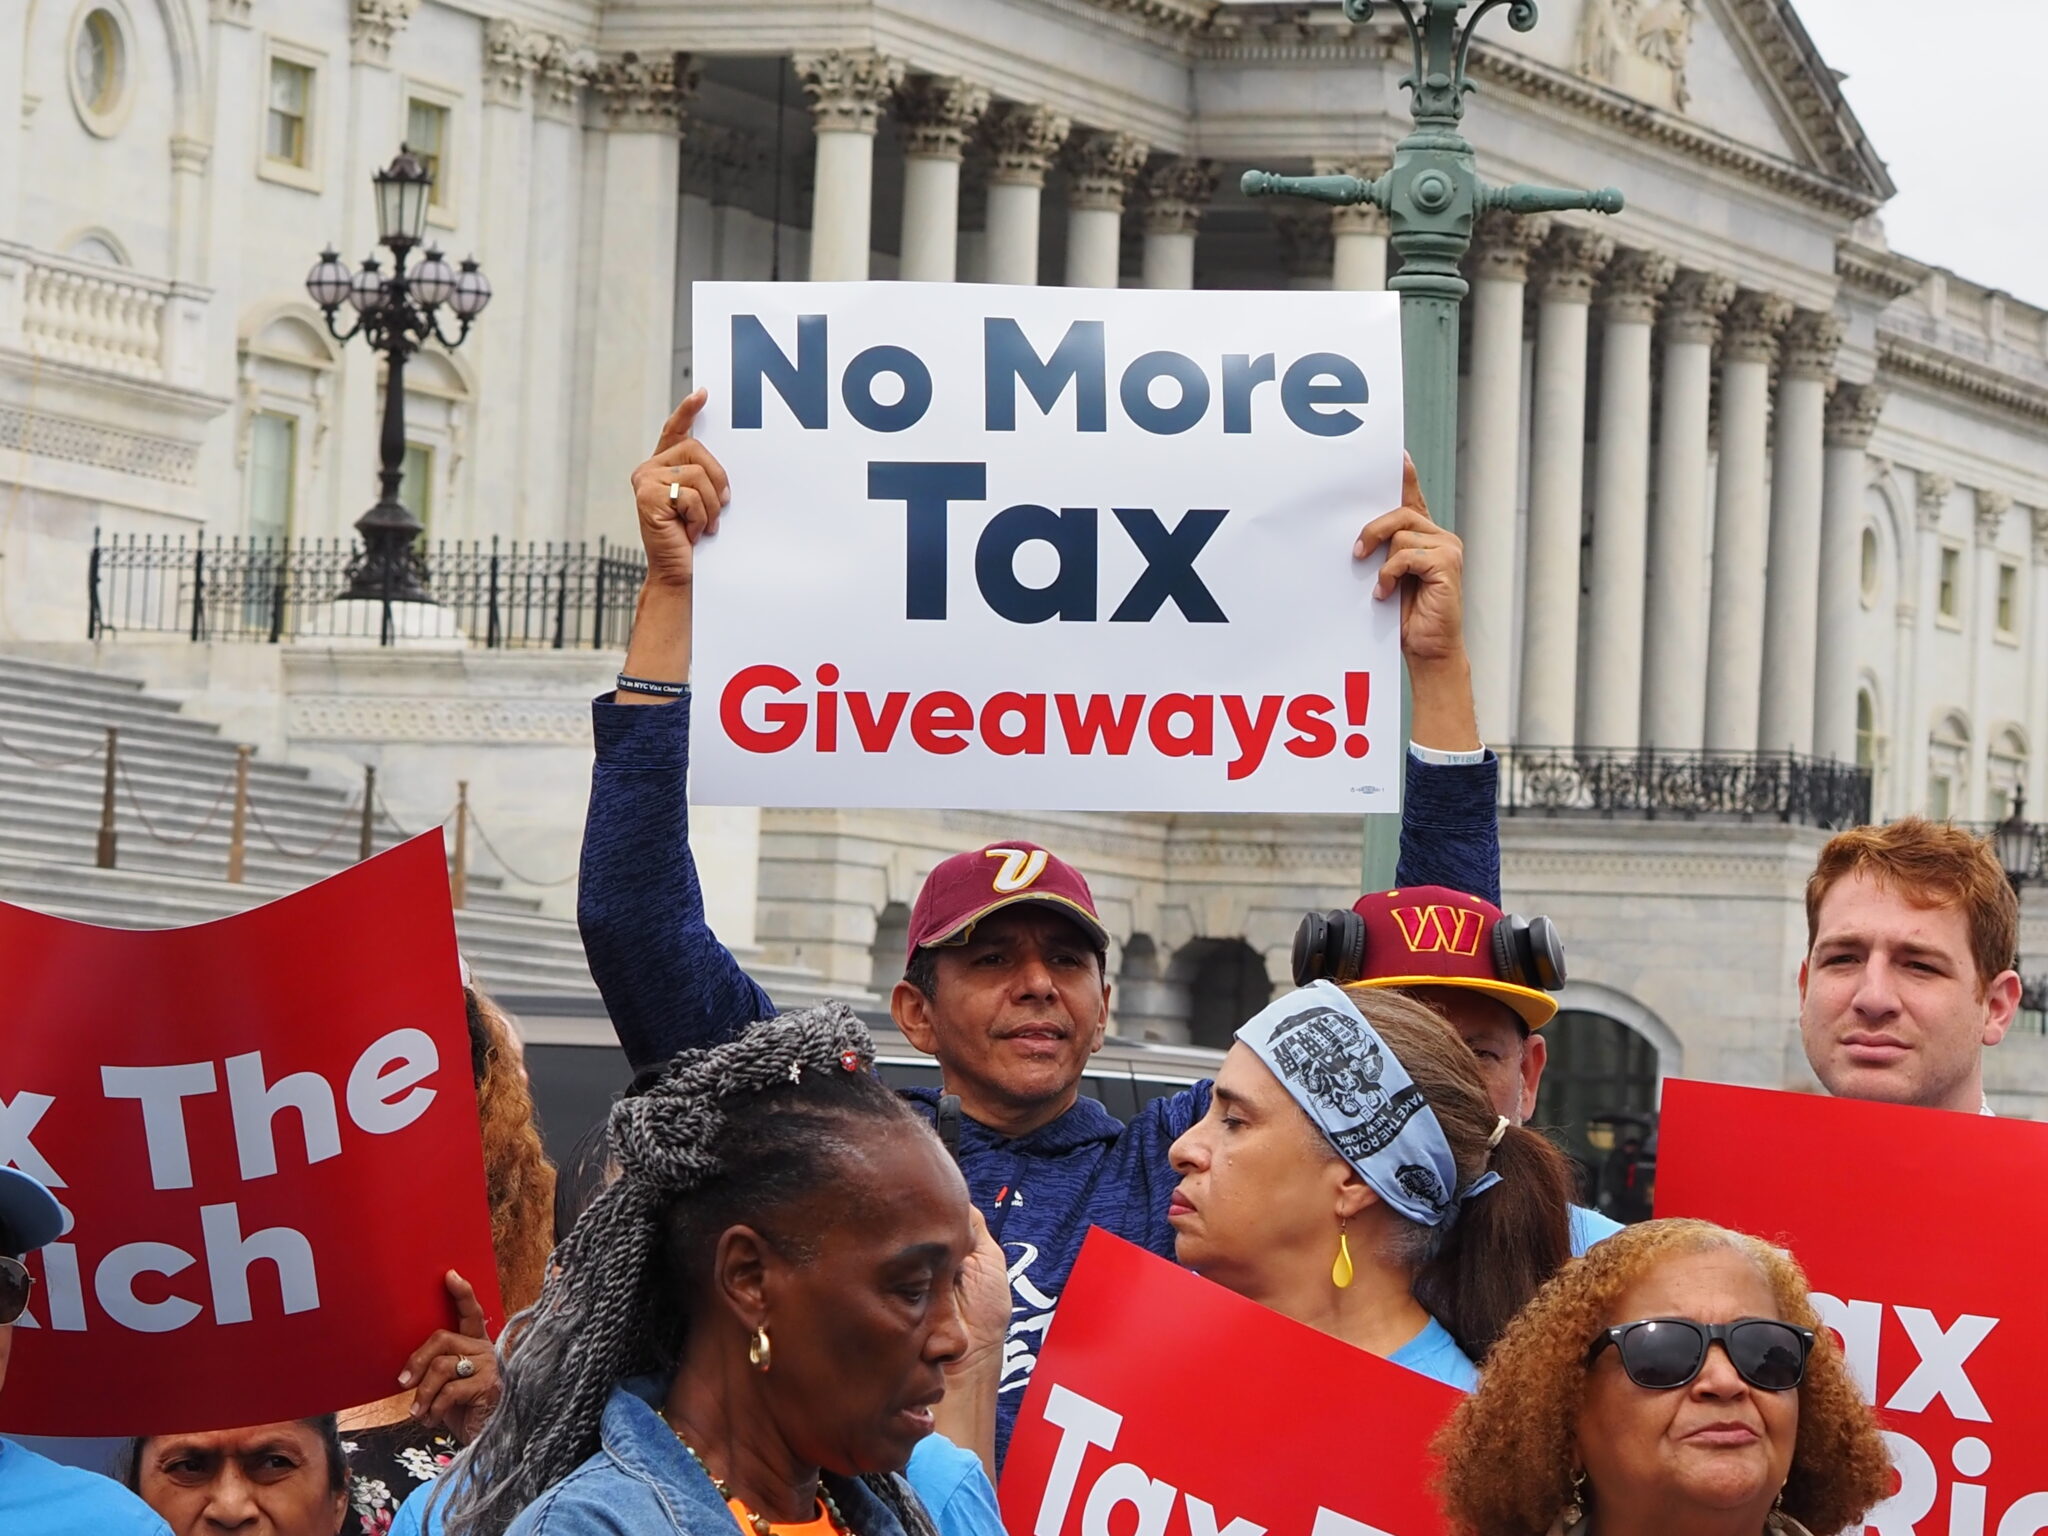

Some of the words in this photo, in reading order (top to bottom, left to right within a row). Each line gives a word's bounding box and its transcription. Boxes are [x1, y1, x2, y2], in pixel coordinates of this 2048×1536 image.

[731, 314, 933, 433] No
[984, 317, 1369, 437] More
[867, 461, 1230, 625] Tax
[634, 681, 649, 690] NYC
[719, 662, 1370, 781] Giveaways!
[1390, 905, 1485, 957] W
[100, 1027, 440, 1190] The
[1337, 1131, 1366, 1145] YORK
[1343, 1135, 1380, 1157] ROAD
[1365, 1114, 1388, 1135] NEW
[1378, 1117, 1401, 1142] THE
[12, 1202, 321, 1333] ich
[1803, 1291, 2000, 1423] ax
